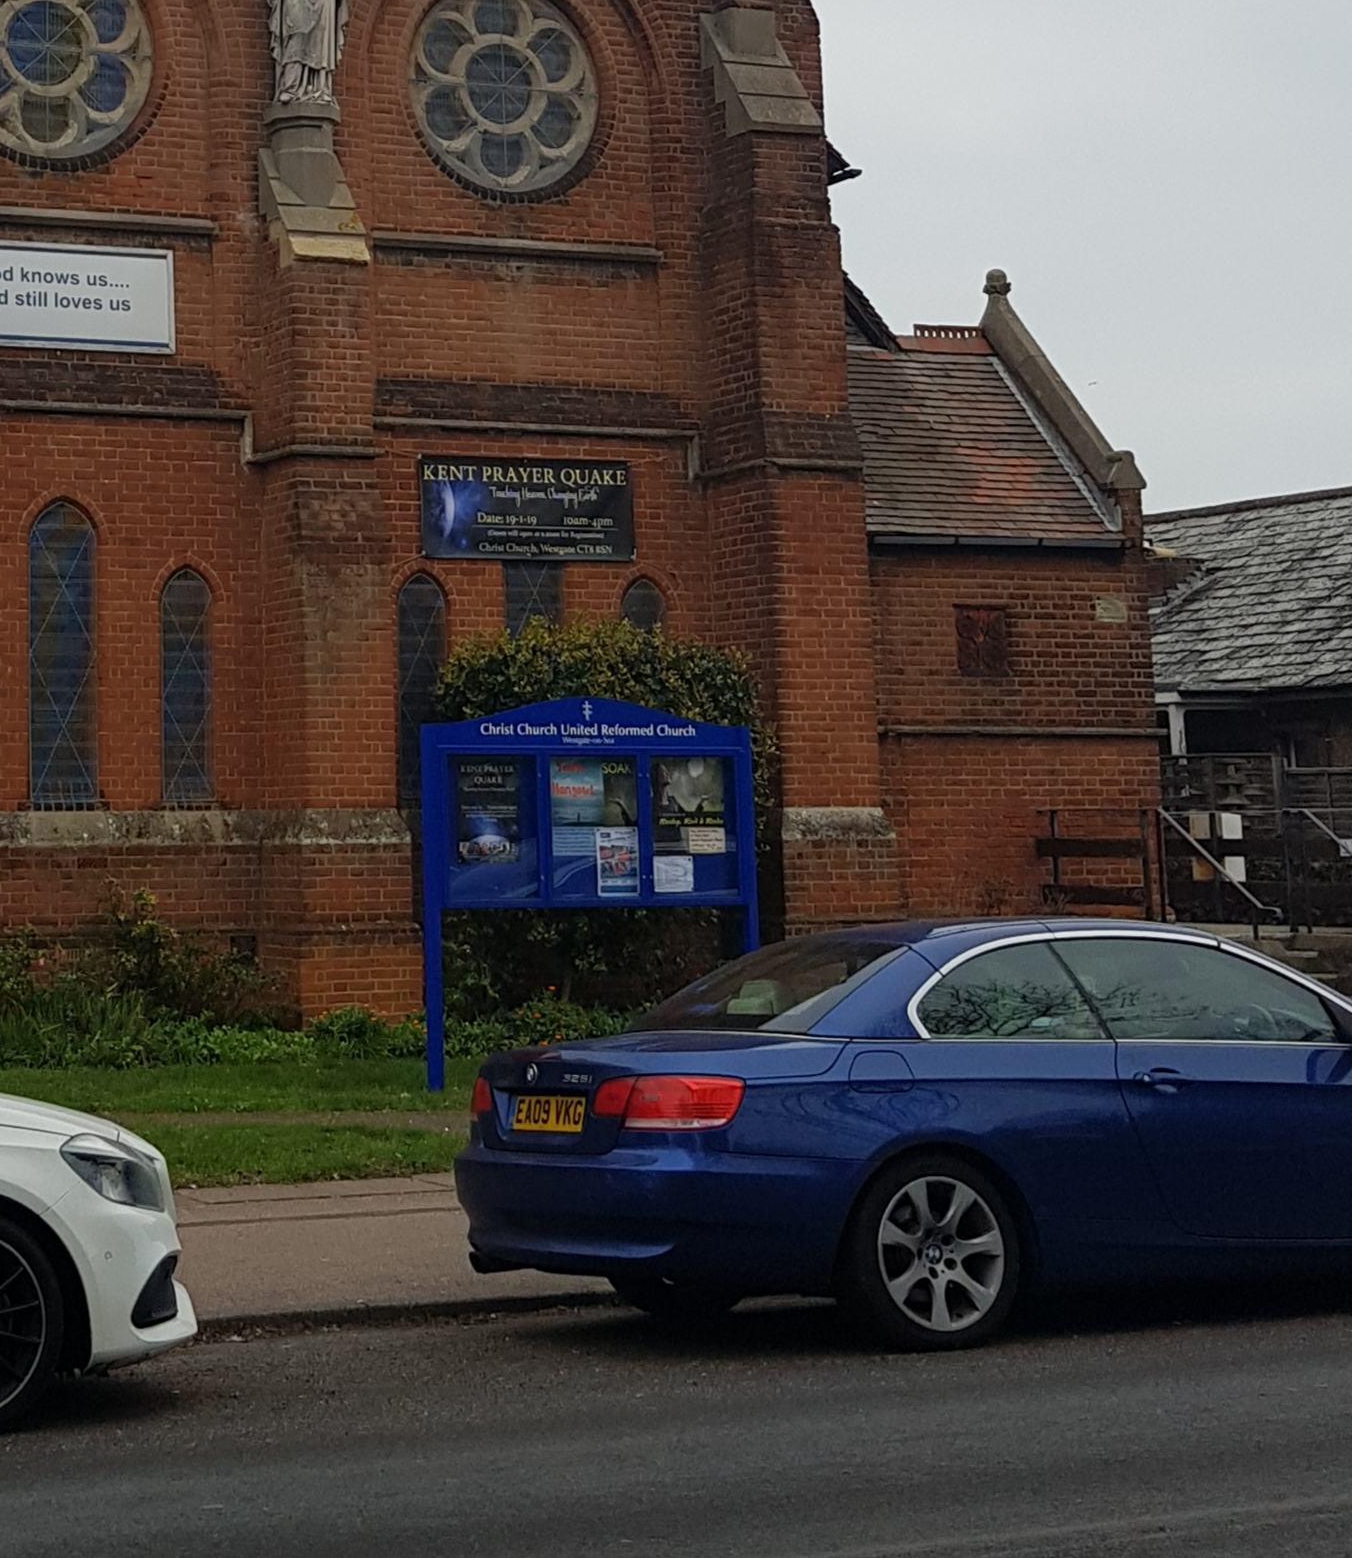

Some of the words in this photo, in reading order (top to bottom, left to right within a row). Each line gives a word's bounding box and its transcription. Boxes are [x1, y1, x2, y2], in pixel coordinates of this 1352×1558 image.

[20, 267, 80, 286] knows
[87, 274, 130, 289] us....
[15, 291, 48, 308] still
[54, 293, 103, 311] loves
[109, 299, 132, 312] us
[423, 464, 477, 481] KENT
[482, 466, 556, 484] PRAYER
[560, 468, 627, 488] QUAKE
[506, 514, 538, 527] 19-1-19
[563, 516, 614, 530] 10am-4pm
[479, 542, 505, 552] Christ
[480, 722, 514, 736] Christ
[517, 722, 557, 736] Church
[560, 723, 598, 736] United
[601, 723, 654, 736] Reformed
[656, 724, 696, 737] Church
[515, 1098, 551, 1125] EA09
[554, 1099, 583, 1126] VKG
